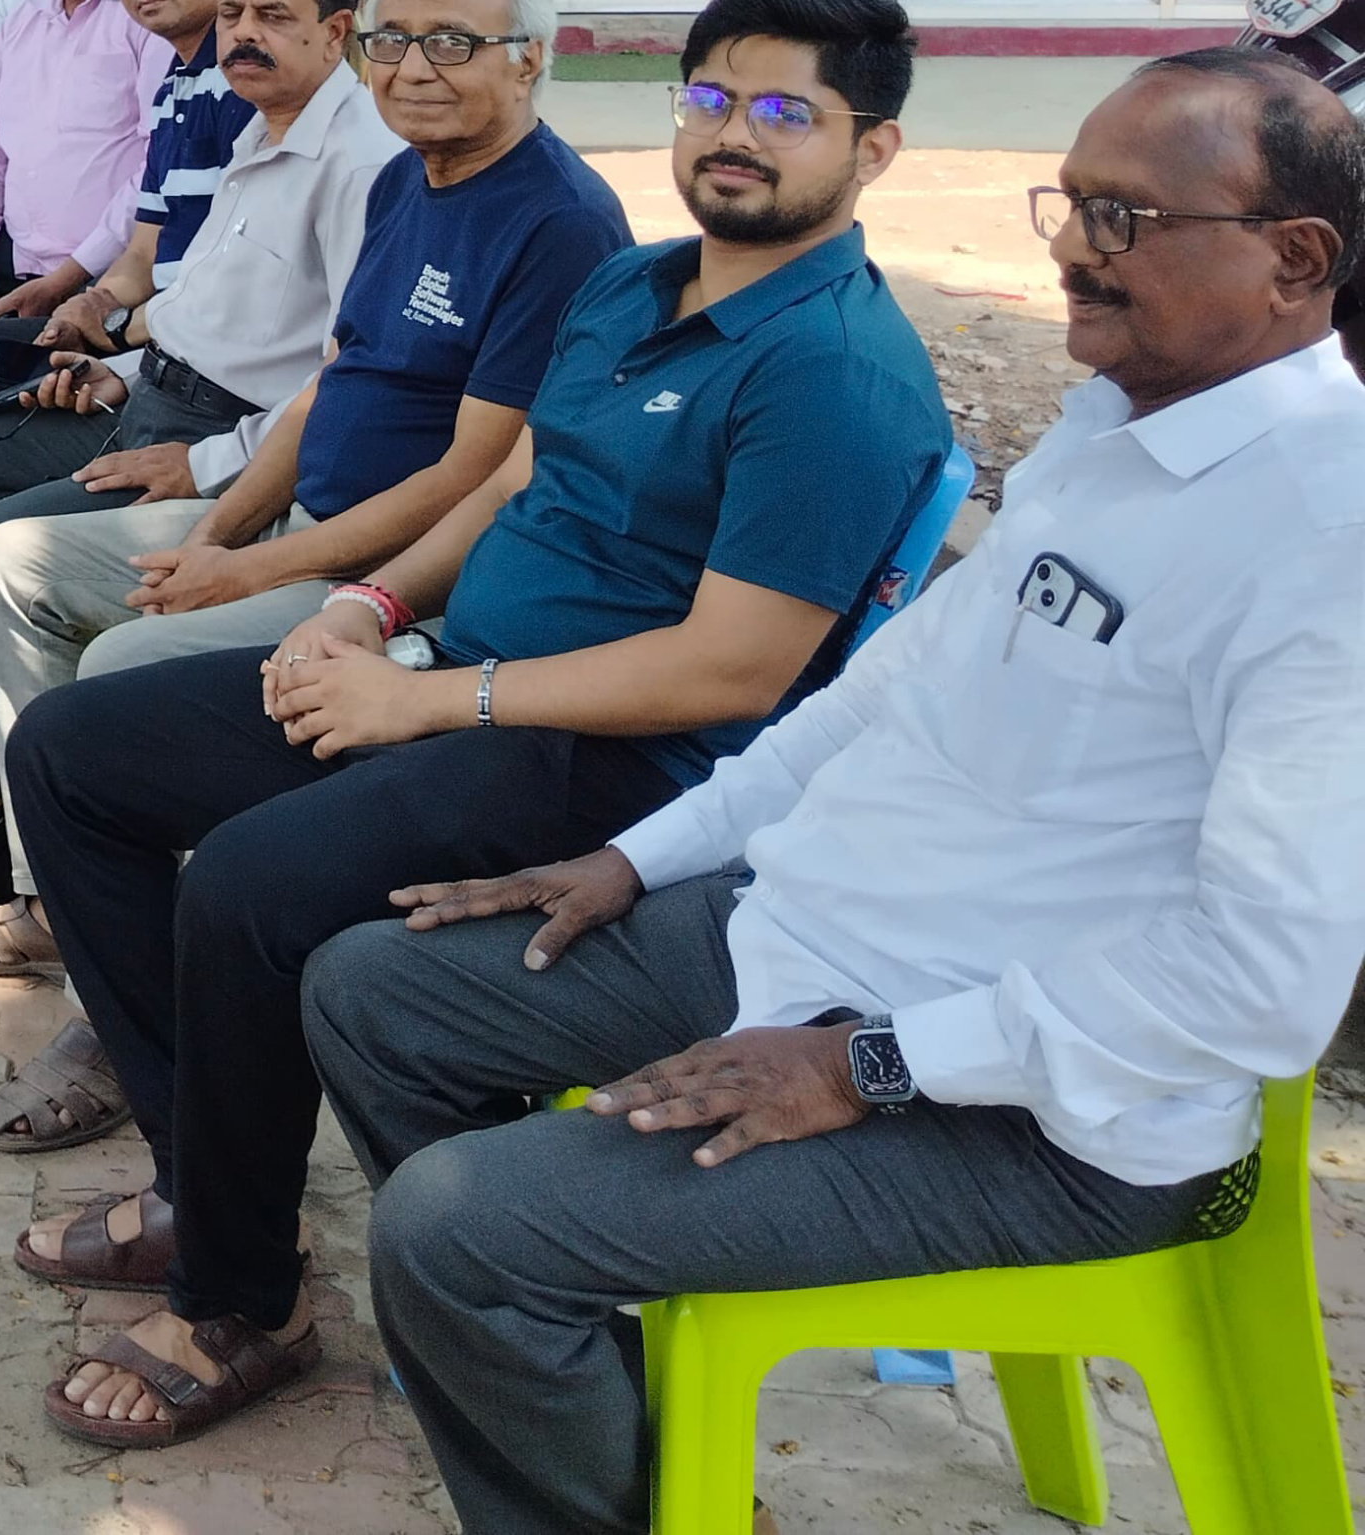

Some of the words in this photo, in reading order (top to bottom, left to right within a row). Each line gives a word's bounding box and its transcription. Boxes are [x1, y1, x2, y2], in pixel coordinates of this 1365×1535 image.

[422, 263, 451, 284] Bosch
[418, 275, 449, 295] Global
[412, 285, 452, 309] Software
[408, 295, 465, 327] Technologies
